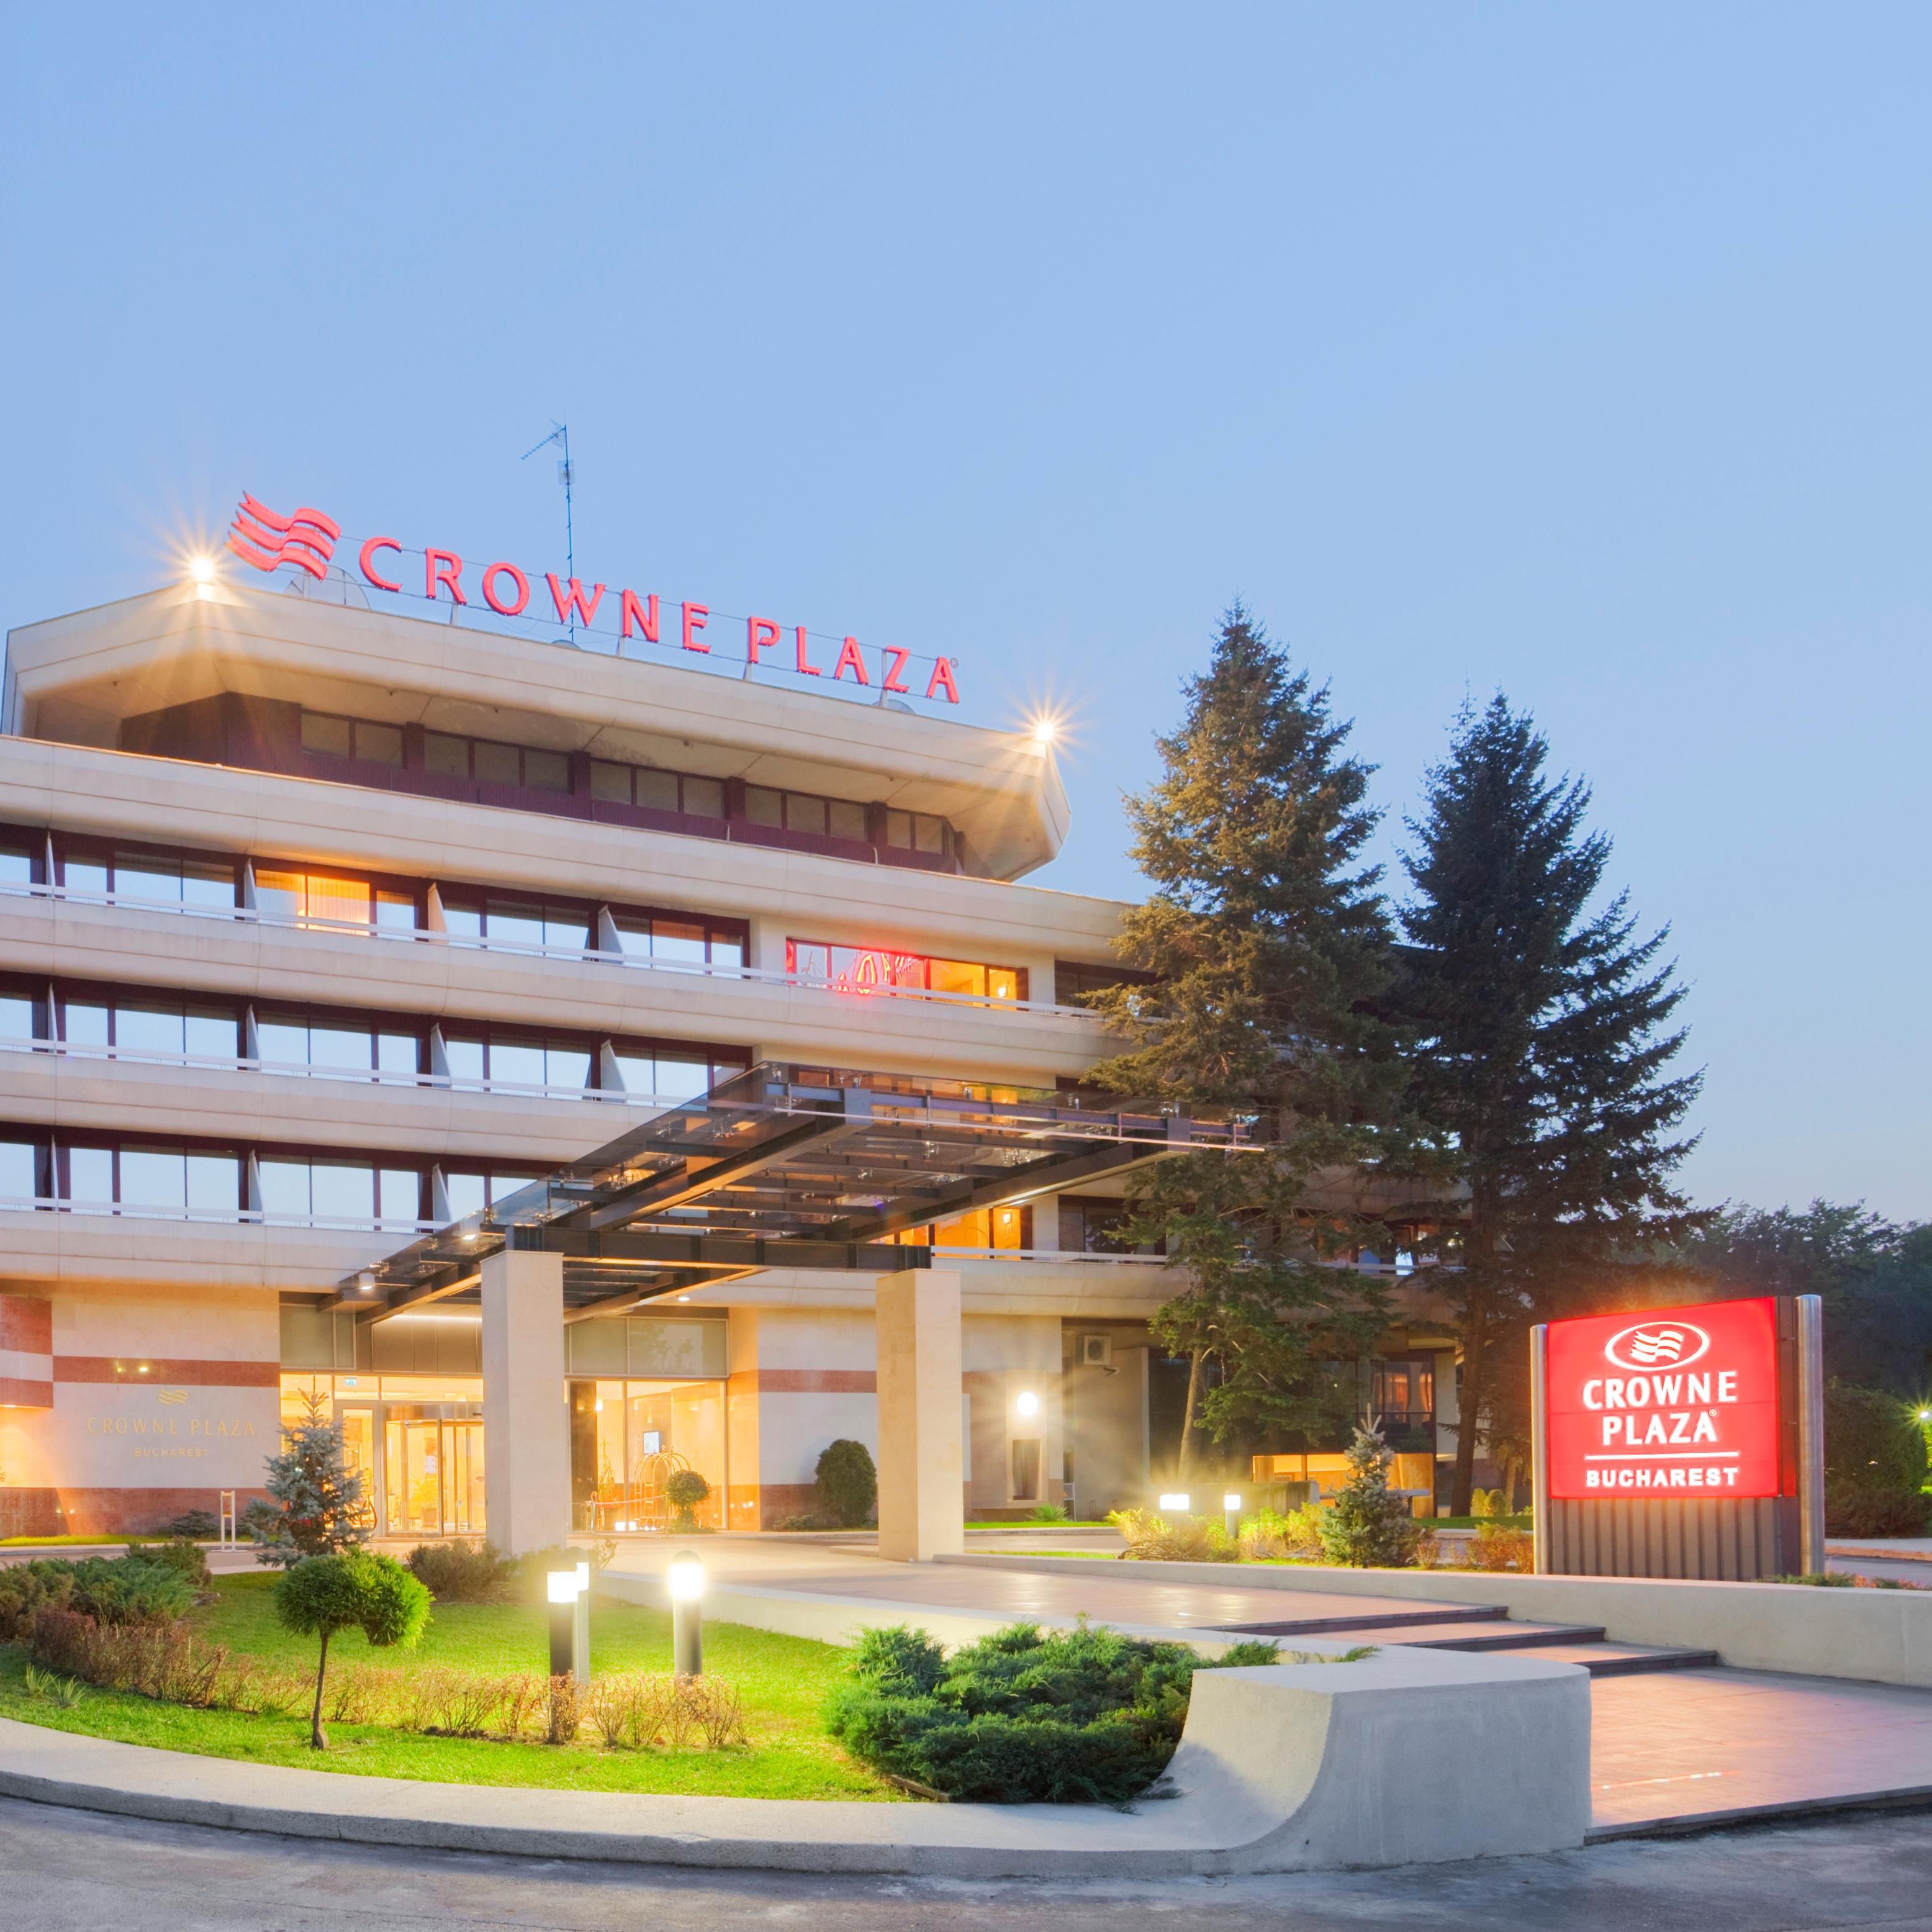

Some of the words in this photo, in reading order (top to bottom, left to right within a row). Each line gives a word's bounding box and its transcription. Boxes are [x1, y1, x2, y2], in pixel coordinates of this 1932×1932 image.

[358, 536, 711, 654] CROWNE
[1582, 1370, 1738, 1411] CROWNE
[88, 1417, 178, 1435] CROWNE
[191, 1420, 255, 1436] PLAZA
[135, 1448, 210, 1457] BUCHAREST
[1585, 1467, 1740, 1488] BUCHAREST
